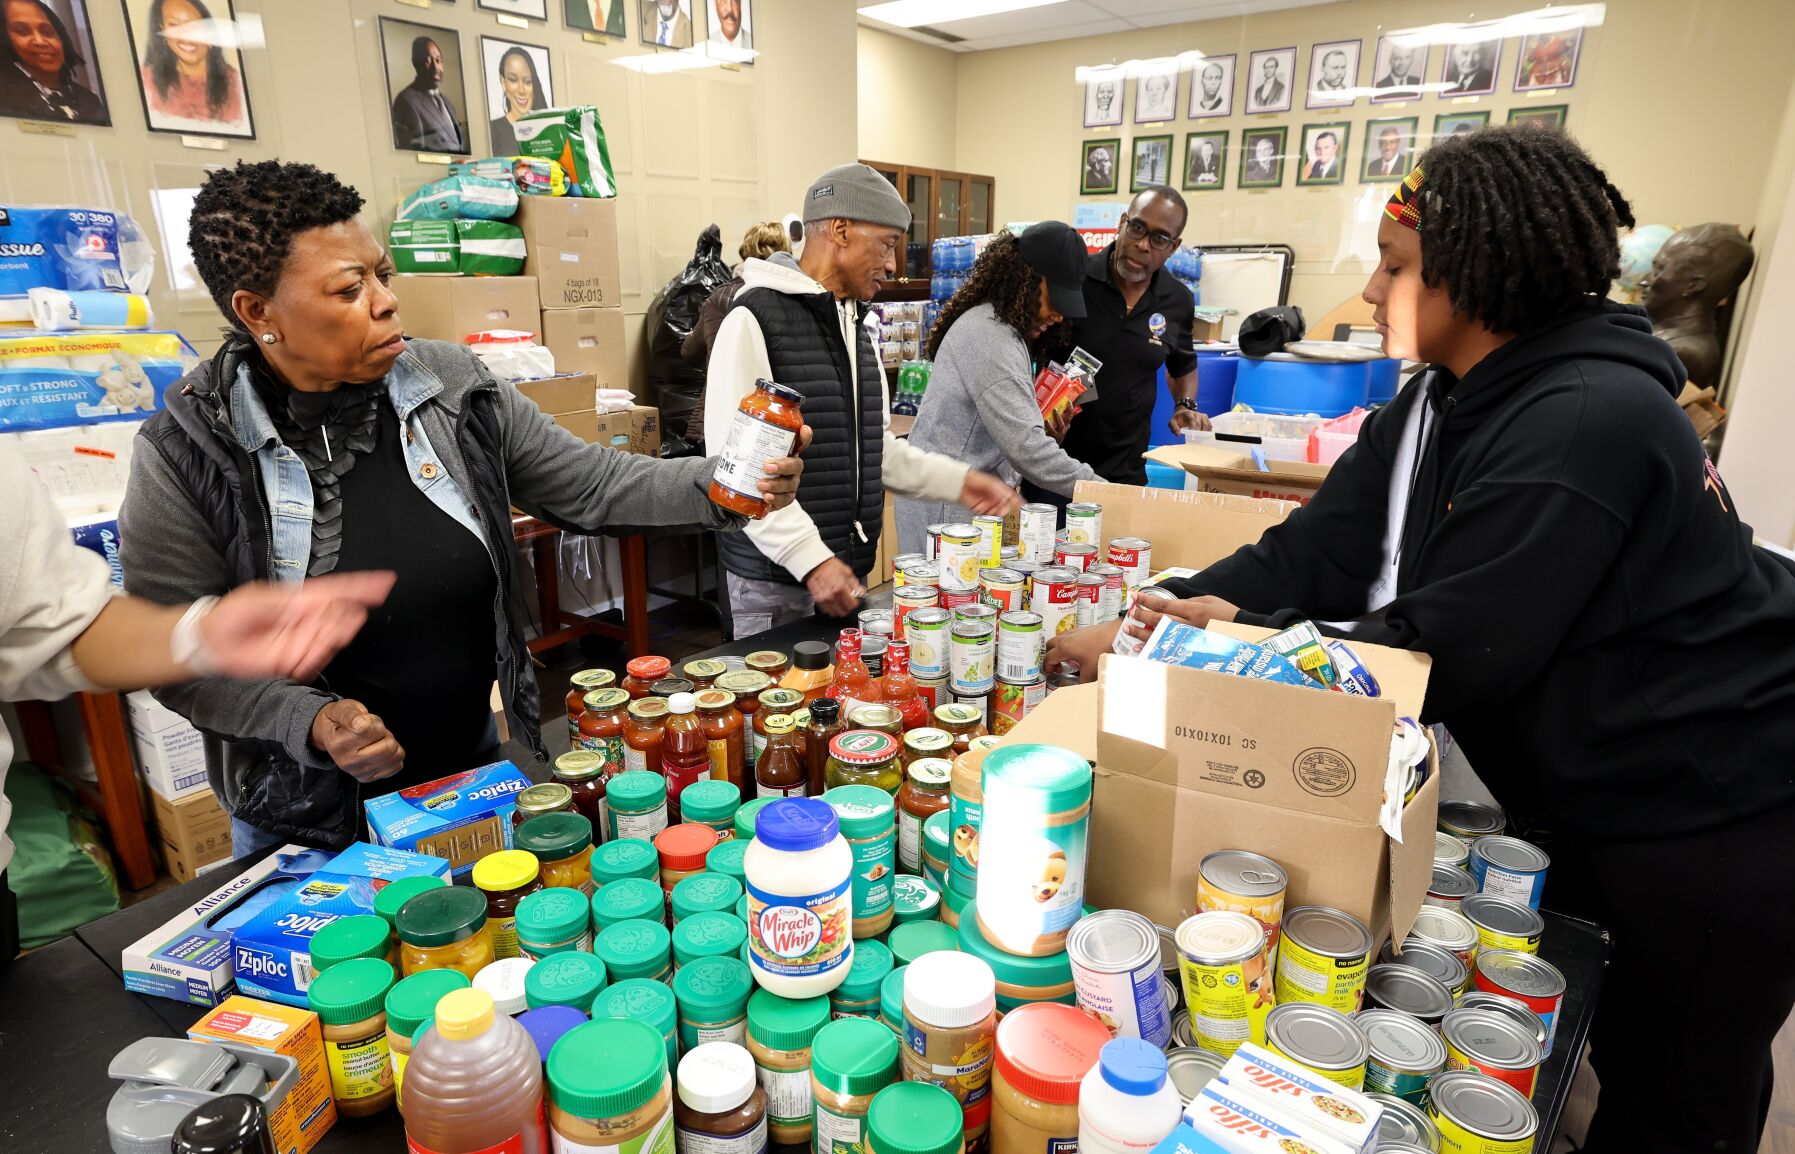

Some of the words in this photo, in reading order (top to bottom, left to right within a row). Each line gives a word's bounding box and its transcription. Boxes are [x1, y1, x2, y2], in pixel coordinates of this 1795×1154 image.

[1081, 232, 1119, 248] GGIE
[0, 243, 45, 256] ssue
[563, 289, 603, 303] NGX-013
[15, 345, 56, 354] FORMAT
[59, 342, 121, 352] ÉCONOMIQUE
[0, 384, 21, 393] OFT
[30, 380, 78, 392] STRONG
[31, 392, 88, 404] RÉSISTANT
[1174, 725, 1232, 746] 10X10X10
[1240, 738, 1257, 750] SC
[467, 781, 525, 801] Ziploc
[194, 876, 251, 916] Alliance
[805, 892, 836, 907] original
[277, 914, 338, 937] ploc
[763, 911, 814, 935] Miracle
[168, 936, 200, 956] MEDIUM
[176, 940, 206, 958] MOYEN
[773, 930, 814, 953] Whip
[150, 962, 182, 977] Alliance
[238, 949, 288, 977] Ziploc
[188, 981, 209, 991] MEDIUM
[189, 987, 208, 997] MOYEN
[1080, 987, 1113, 1003] CUSTARD
[1081, 996, 1114, 1012] ANGLAISE
[342, 1045, 378, 1060] smooth
[342, 1057, 362, 1065] peanut
[362, 1051, 380, 1061] butter
[343, 1063, 363, 1071] beurre
[1254, 1058, 1276, 1072] SALT
[1243, 1065, 1310, 1097] sifto
[1220, 1097, 1244, 1112] SALT
[1208, 1105, 1277, 1139] sifto
[1057, 1143, 1079, 1151] KIRK
[1440, 1130, 1463, 1151] ment
